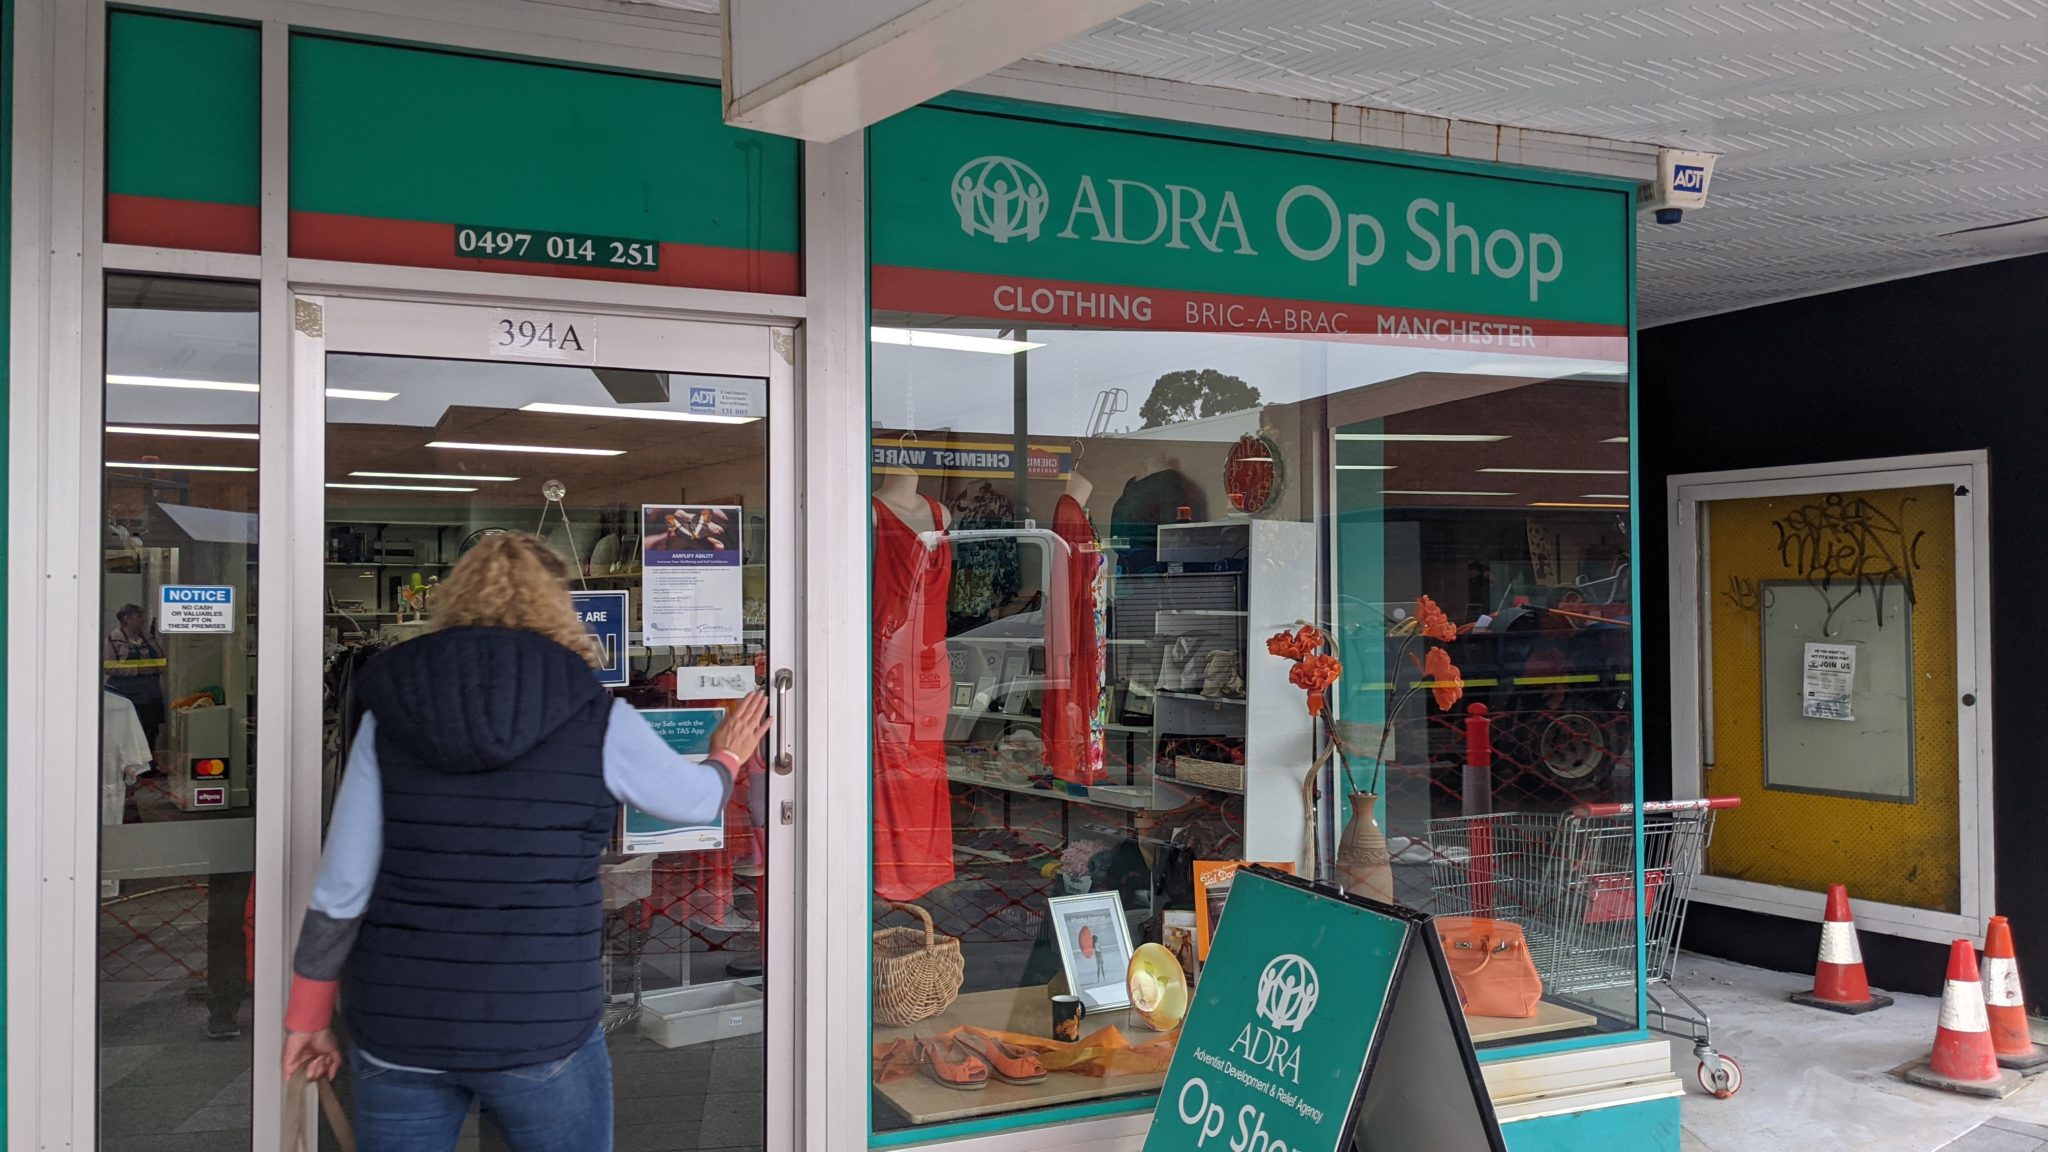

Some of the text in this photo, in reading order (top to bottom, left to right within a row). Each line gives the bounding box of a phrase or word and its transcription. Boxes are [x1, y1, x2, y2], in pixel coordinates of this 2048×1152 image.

[1673, 169, 1704, 188] ADT
[459, 229, 657, 266] 0497 014 251
[1057, 175, 1563, 301] ADRA Op Shop
[993, 285, 1536, 348] CLOTHING BRIC-A-BRAC MANCHESTER
[498, 319, 585, 351] 394A
[691, 390, 715, 405] ADT
[169, 590, 226, 601] NOTICE
[586, 611, 607, 622] ARE
[691, 728, 704, 736] App
[1229, 1022, 1301, 1085] ADRA
[1193, 1046, 1324, 1125] Adventist Development & Relief Agency
[1179, 1077, 1302, 1152] Op Sh
